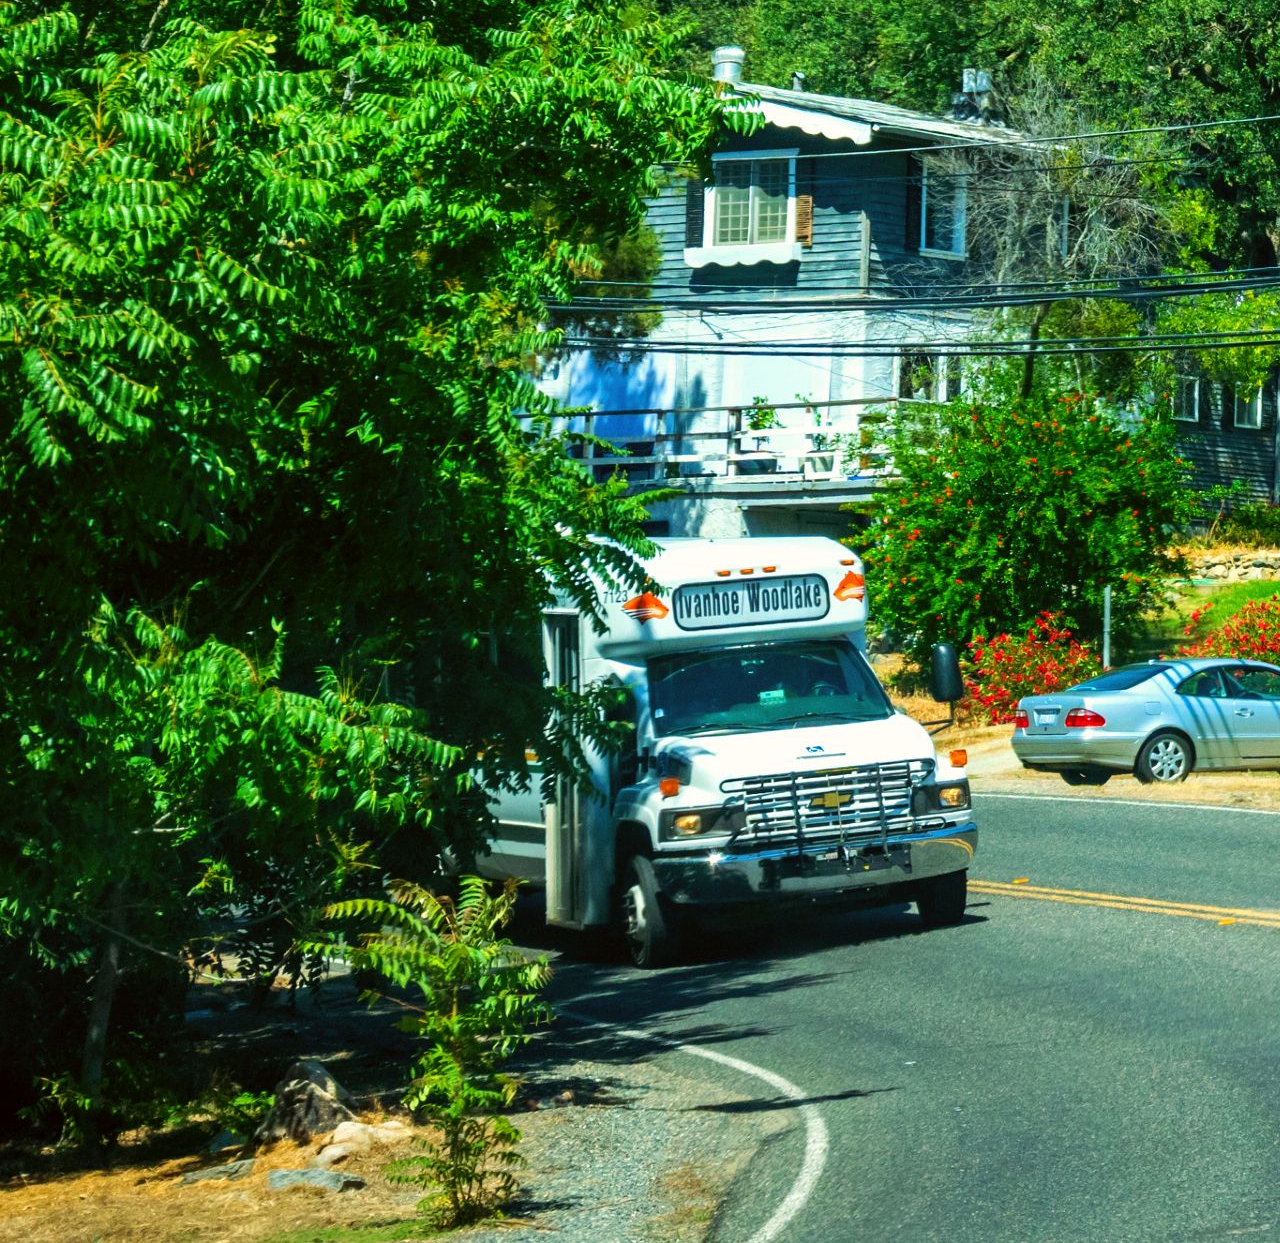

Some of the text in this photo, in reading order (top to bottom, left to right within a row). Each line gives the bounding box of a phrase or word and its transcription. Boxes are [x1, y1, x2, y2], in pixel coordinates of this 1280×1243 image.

[603, 590, 628, 604] 7123
[679, 578, 821, 619] Ivanhoe Woodlake
